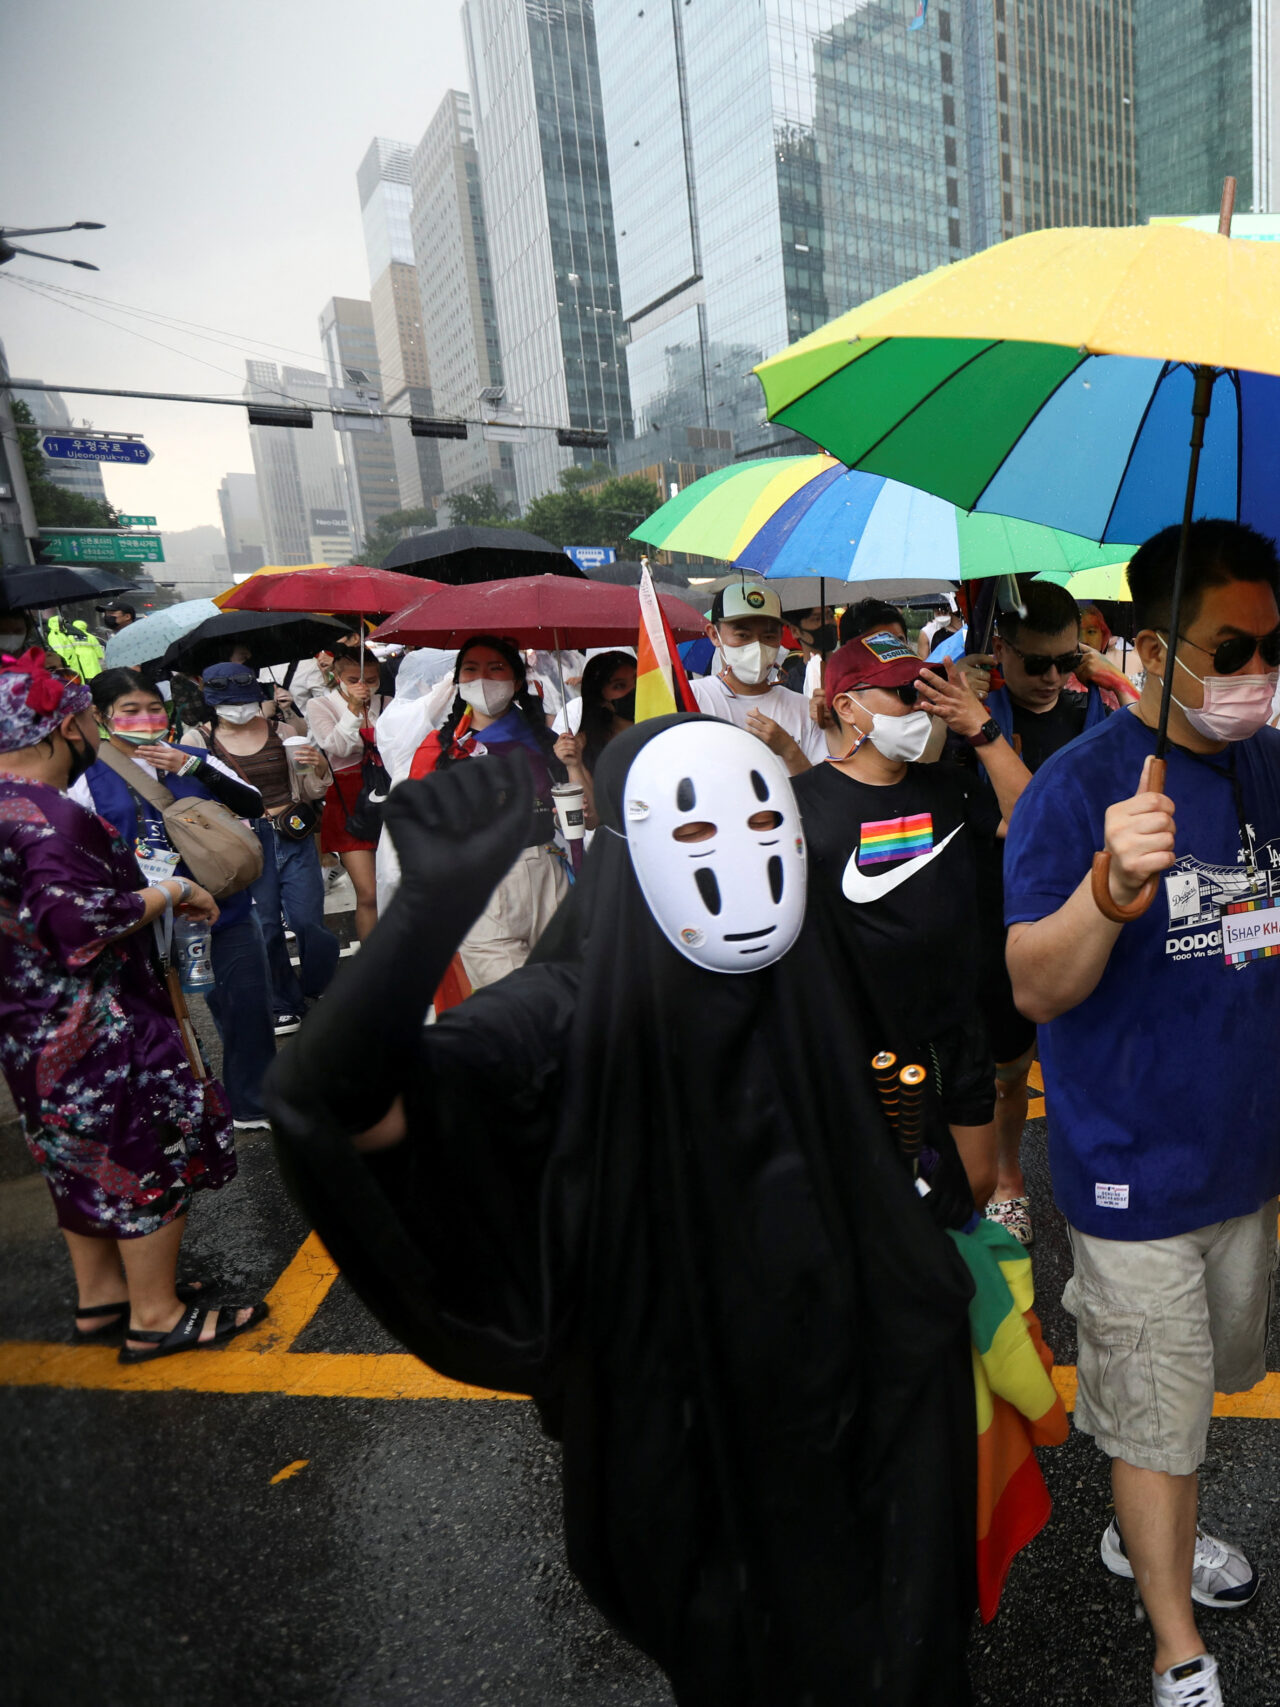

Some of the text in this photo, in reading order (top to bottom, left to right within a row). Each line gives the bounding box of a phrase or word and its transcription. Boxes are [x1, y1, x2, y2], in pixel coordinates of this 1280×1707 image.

[47, 443, 59, 452] 11
[72, 440, 123, 452] 우정국로
[67, 450, 131, 461] Ujeongguk-ro
[133, 449, 146, 458] 15
[1226, 925, 1261, 944] iSHAP
[1172, 953, 1192, 961] 1000
